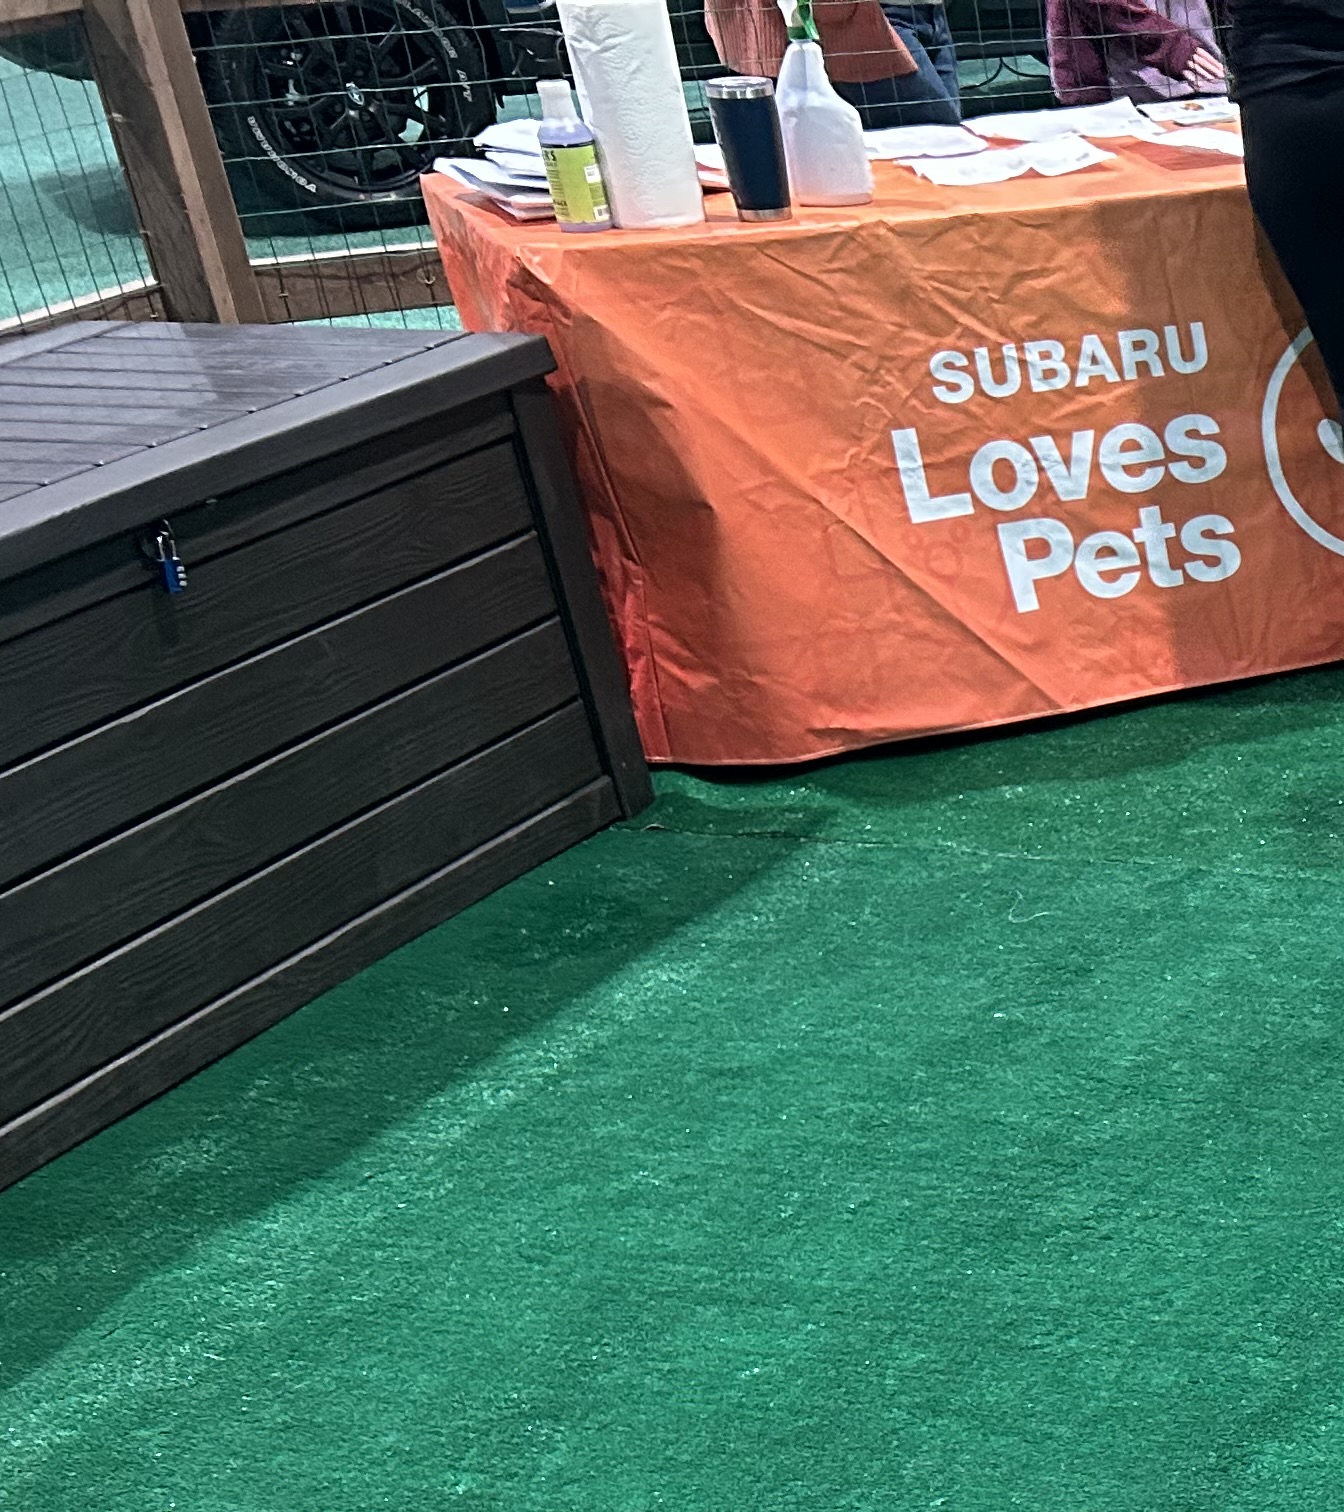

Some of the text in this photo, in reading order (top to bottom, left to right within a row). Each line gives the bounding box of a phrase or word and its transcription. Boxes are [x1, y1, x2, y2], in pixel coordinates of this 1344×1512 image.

[247, 115, 317, 193] YOKOHAMA
[929, 321, 1208, 404] SUBARU
[891, 413, 1227, 524] Loves
[997, 505, 1242, 613] Pets
